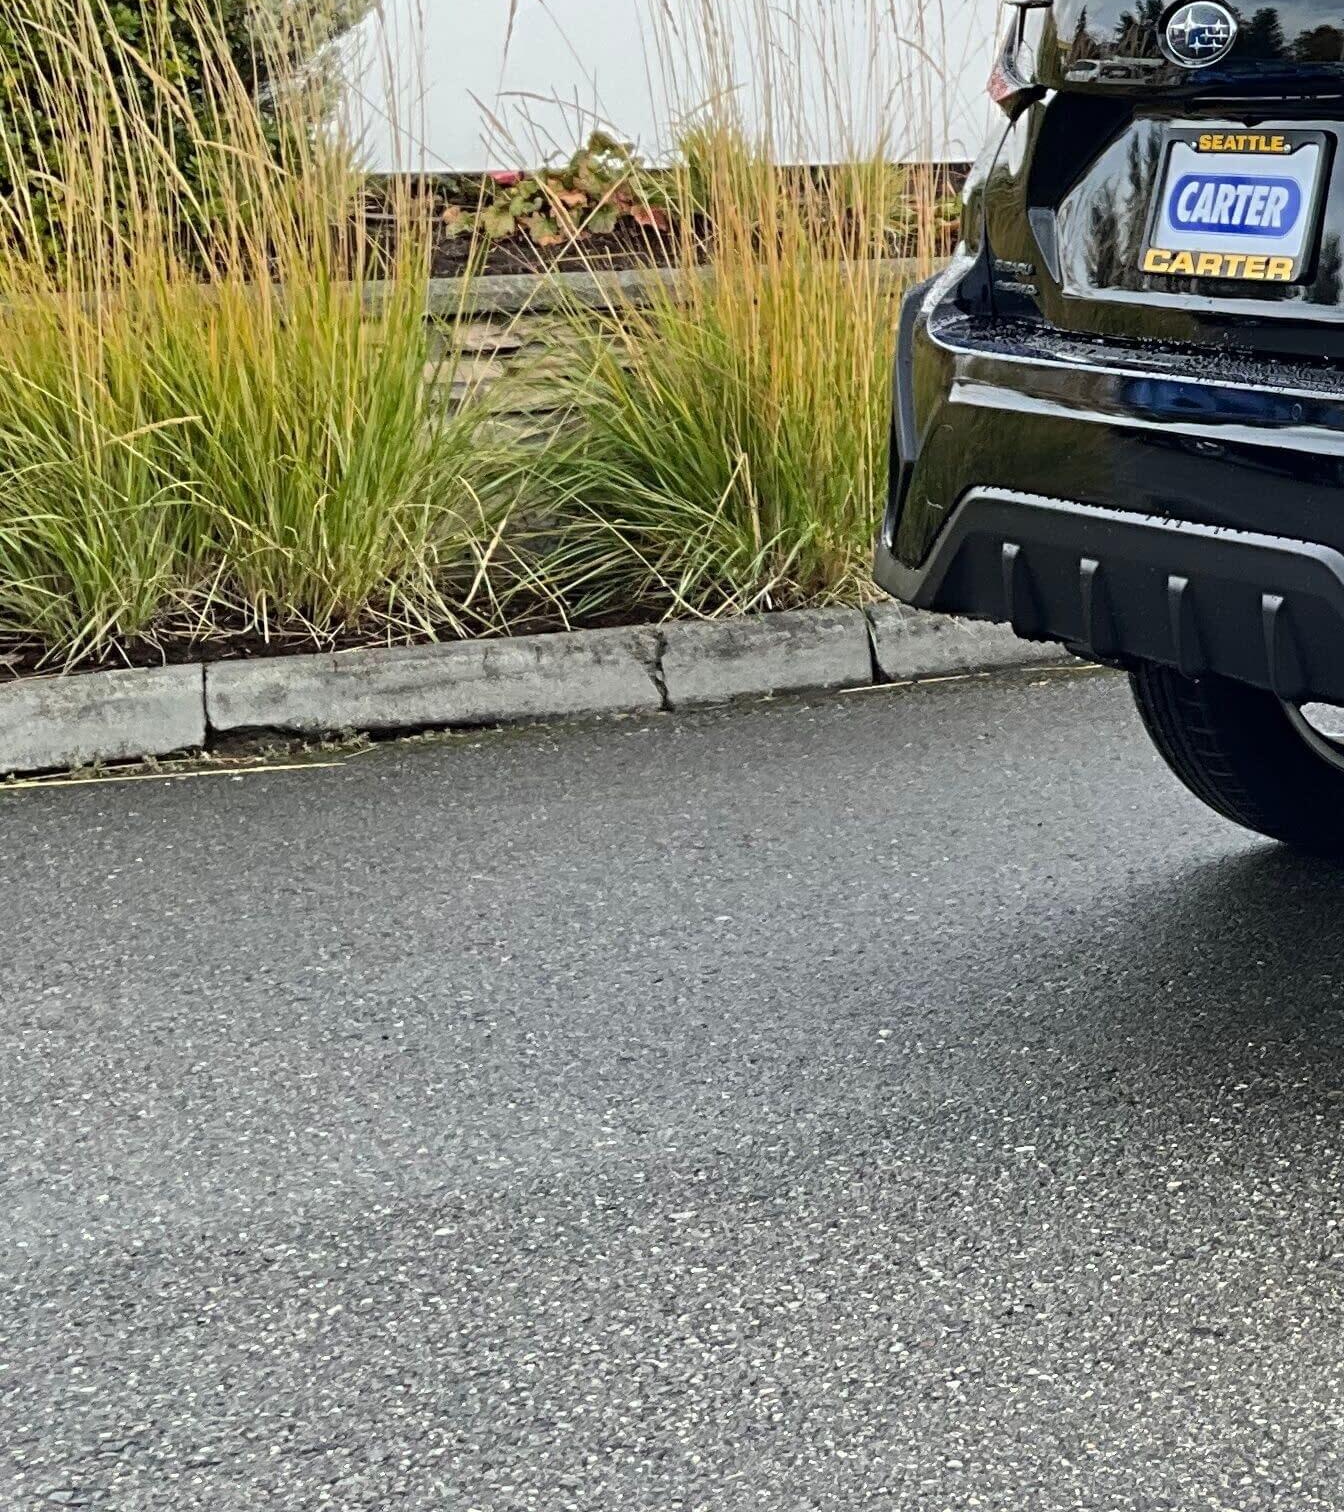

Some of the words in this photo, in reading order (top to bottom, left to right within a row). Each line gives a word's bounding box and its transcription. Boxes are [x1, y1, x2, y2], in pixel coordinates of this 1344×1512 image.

[1199, 135, 1284, 152] SEATTLE
[1177, 181, 1289, 228] CARTER
[1144, 248, 1293, 281] CARTER
